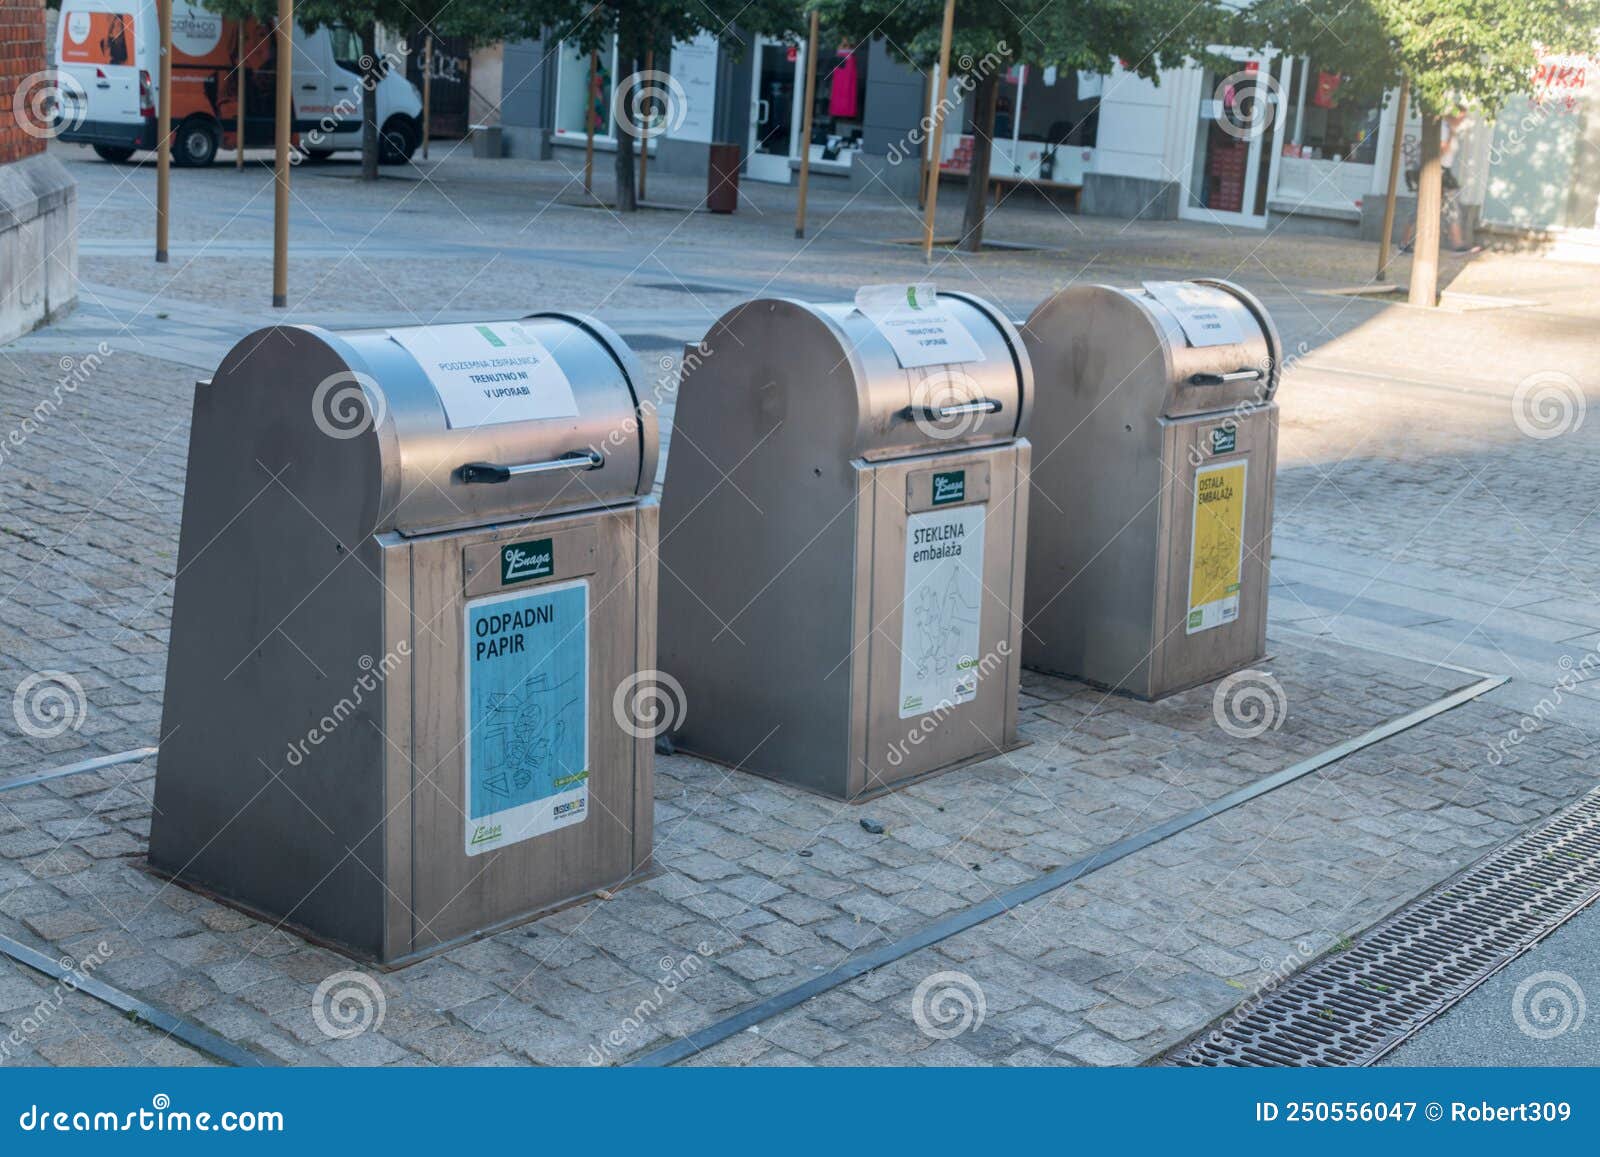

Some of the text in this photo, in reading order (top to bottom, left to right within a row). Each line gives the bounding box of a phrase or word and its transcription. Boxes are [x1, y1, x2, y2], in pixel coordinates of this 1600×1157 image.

[469, 371, 528, 384] TRENUTNO NI
[492, 386, 530, 398] UPORABI
[914, 523, 965, 544] STEKLENA
[514, 551, 550, 568] Snaga
[476, 604, 553, 637] ODPADNI
[476, 633, 525, 661] PAPIR
